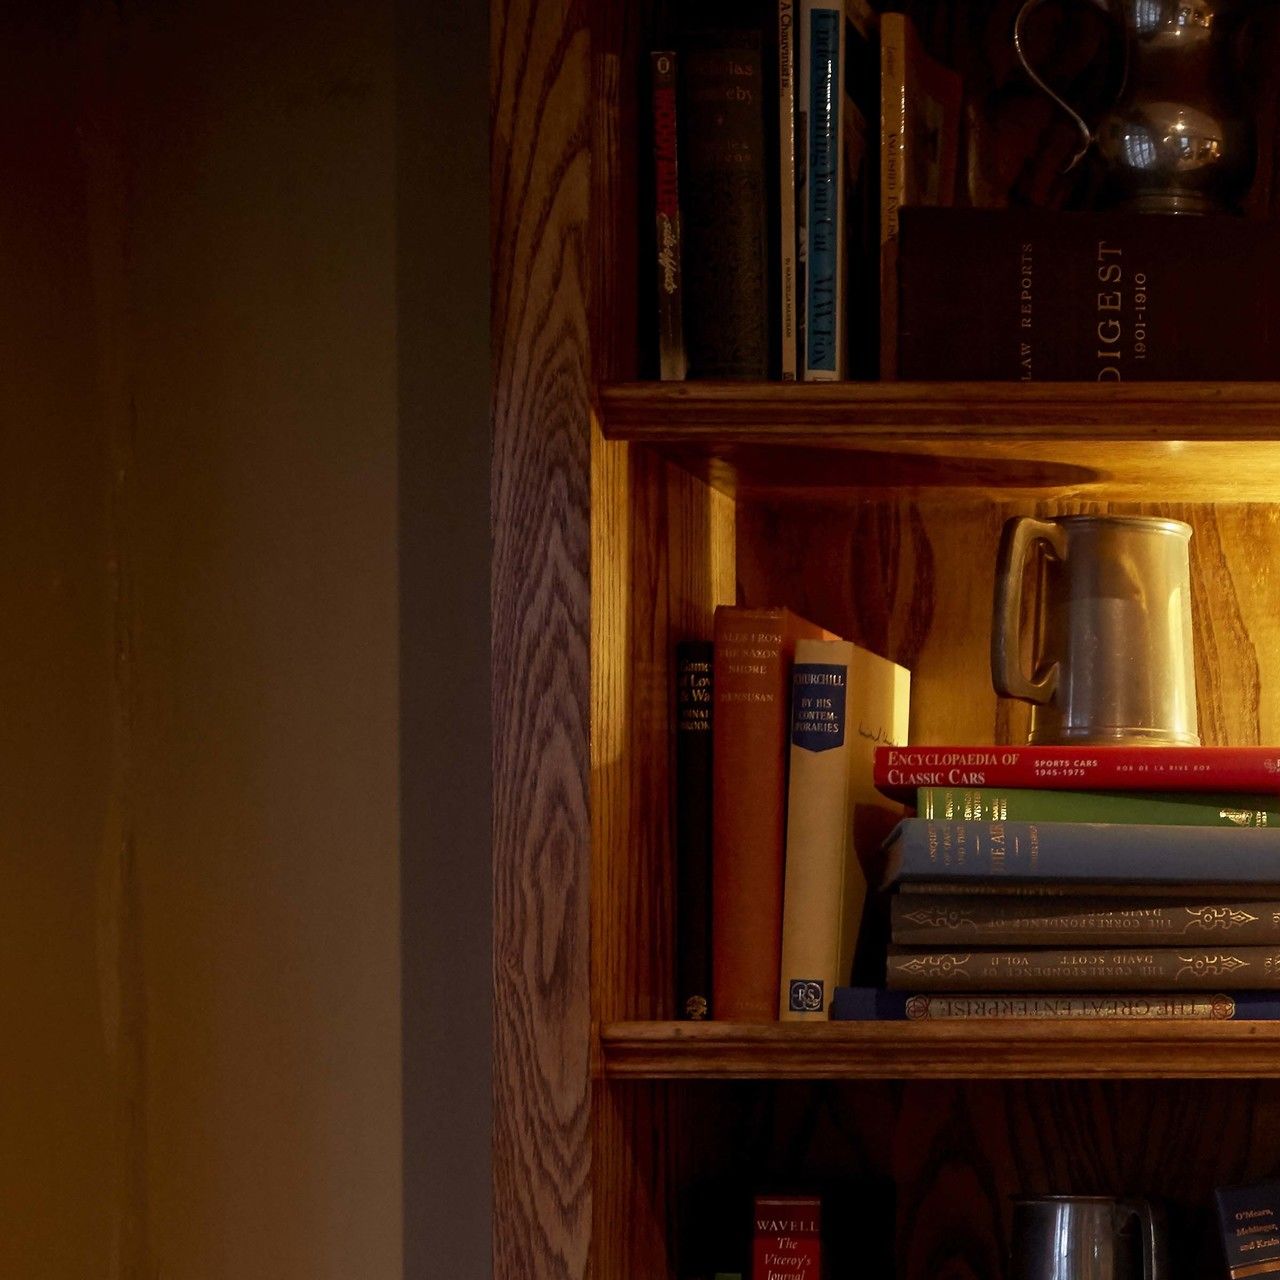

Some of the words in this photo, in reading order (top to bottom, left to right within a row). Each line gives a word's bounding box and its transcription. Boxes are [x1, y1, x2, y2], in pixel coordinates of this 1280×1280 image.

[811, 14, 837, 168] Understanding
[813, 170, 837, 211] Your
[814, 219, 835, 252] Cat
[1020, 240, 1033, 329] REPORTS
[1097, 241, 1122, 381] DIGEST
[1134, 273, 1147, 359] 1901-1910
[811, 333, 834, 366] Fox
[1020, 343, 1033, 381] LAW
[815, 697, 832, 709] HIS
[887, 751, 998, 767] ENCYCLOPAEDIA
[1001, 753, 1020, 767] OF
[1034, 759, 1070, 768] SPORTS
[1073, 759, 1098, 768] CARS
[887, 768, 944, 785] CLASSIC
[948, 769, 986, 785] CARS
[1034, 768, 1086, 776] 1945-1975
[1080, 998, 1151, 1018] GREAT
[1157, 998, 1198, 1017] THE
[756, 1219, 818, 1232] WAVELL
[777, 1237, 798, 1250] The
[763, 1252, 812, 1268] Viceroy's
